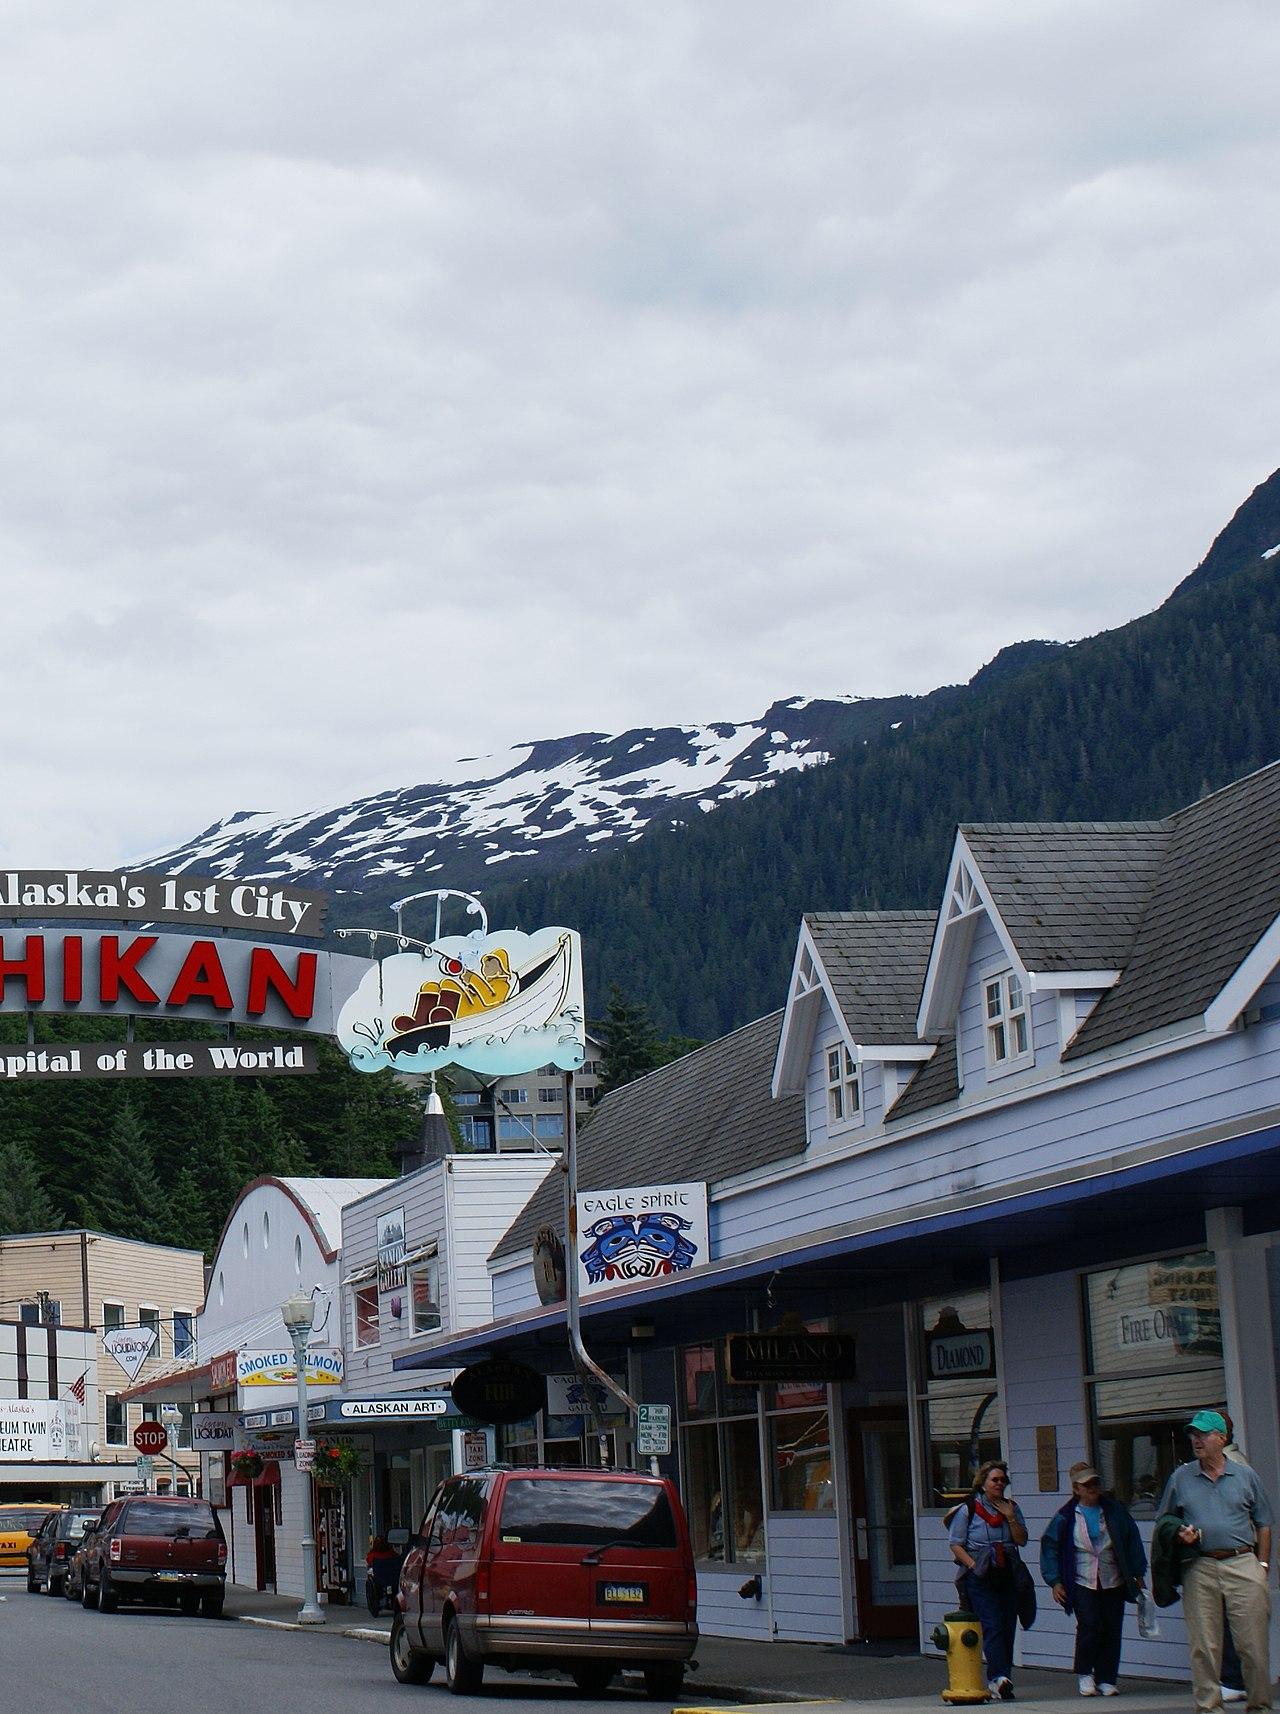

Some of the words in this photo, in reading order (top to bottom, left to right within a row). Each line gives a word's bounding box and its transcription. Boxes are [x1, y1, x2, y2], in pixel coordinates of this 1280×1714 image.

[160, 881, 222, 915] 1st
[229, 885, 313, 932] City
[97, 1050, 128, 1072] of
[142, 1048, 197, 1071] the
[207, 1046, 306, 1070] World
[584, 1195, 635, 1212] EAGLE
[641, 1191, 690, 1209] SPIRIT
[746, 1339, 843, 1361] MILANO
[936, 1344, 985, 1371] DIAMOND
[239, 1353, 288, 1375] SMOKED
[293, 1353, 342, 1373] SLMON
[352, 1403, 409, 1414] ALASKAN
[414, 1402, 436, 1412] ART
[640, 1407, 648, 1420] 2
[23, 1421, 47, 1434] TWIN
[135, 1432, 165, 1445] STOP
